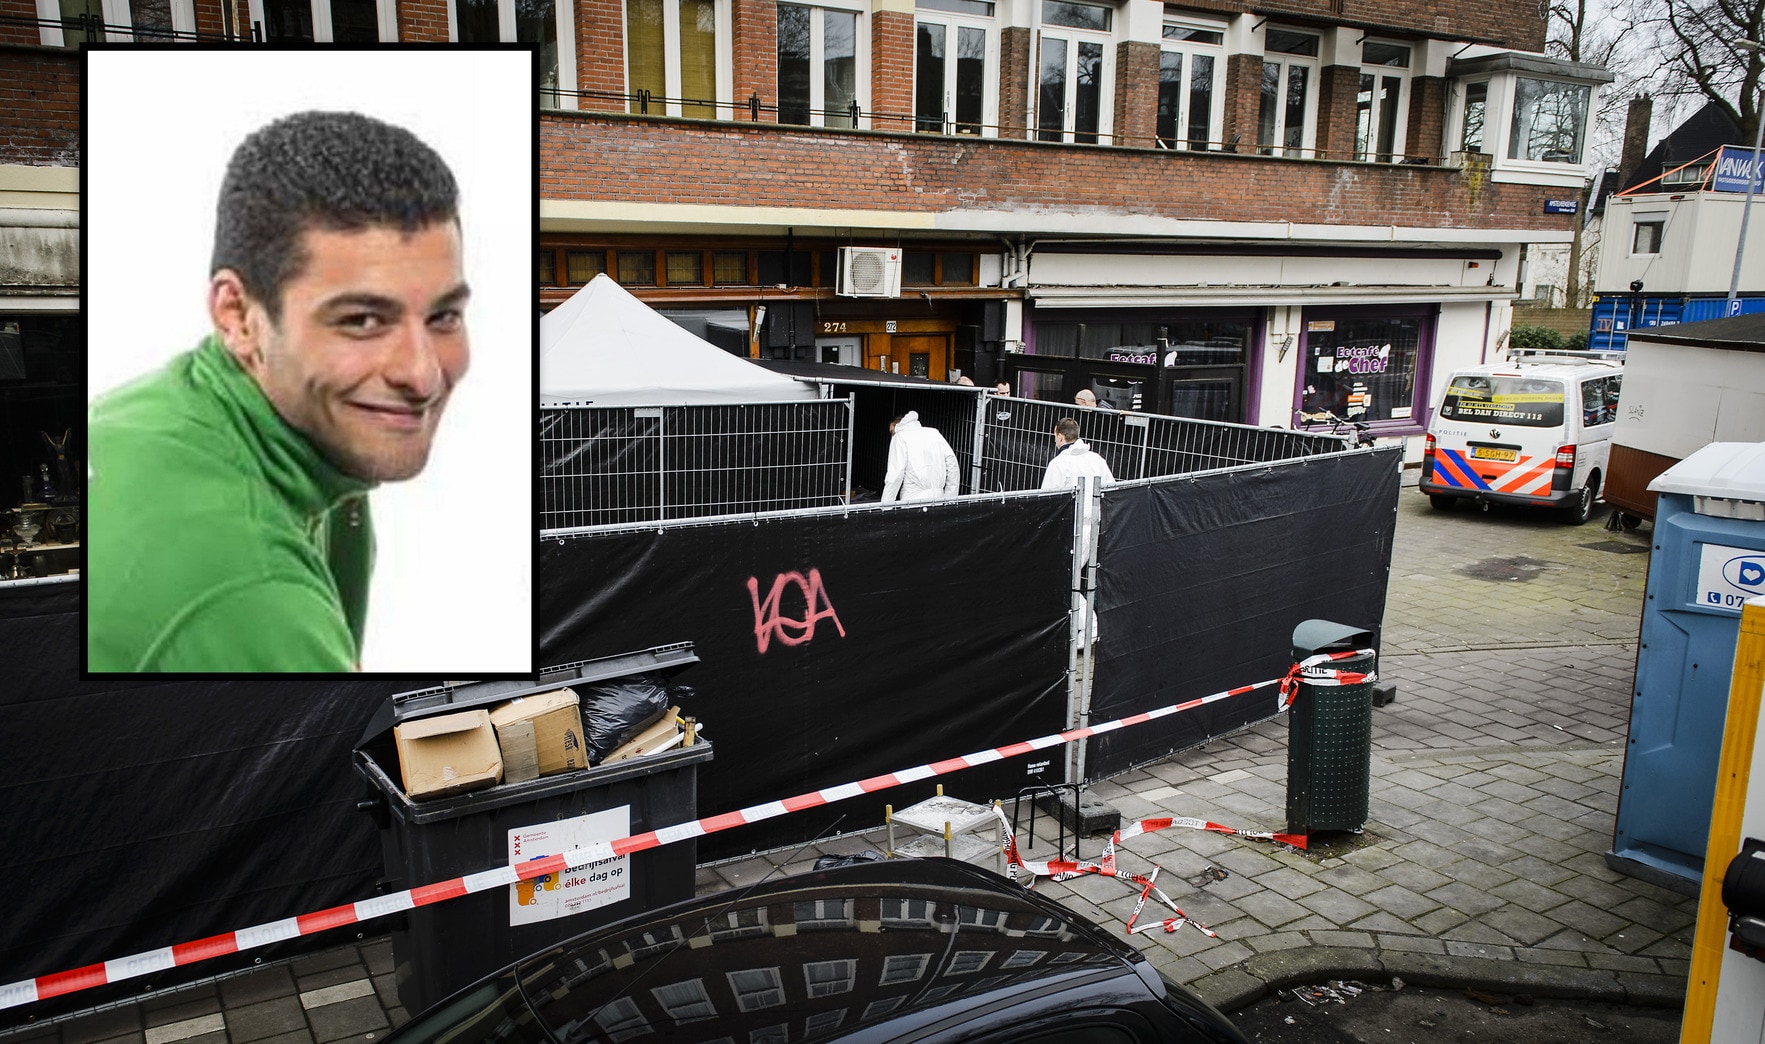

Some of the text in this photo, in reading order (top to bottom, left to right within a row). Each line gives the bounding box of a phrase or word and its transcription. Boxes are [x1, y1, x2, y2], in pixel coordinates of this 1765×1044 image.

[1730, 302, 1740, 315] P
[824, 322, 847, 332] 274
[886, 322, 896, 332] 272
[1336, 346, 1380, 358] Eetcafé
[1110, 353, 1157, 365] Eetcaf
[1348, 357, 1388, 374] Chef
[1492, 411, 1526, 419] DIRECT
[1438, 429, 1468, 437] POLITIE
[1726, 594, 1748, 608] 07
[565, 868, 623, 888] élke dag op
